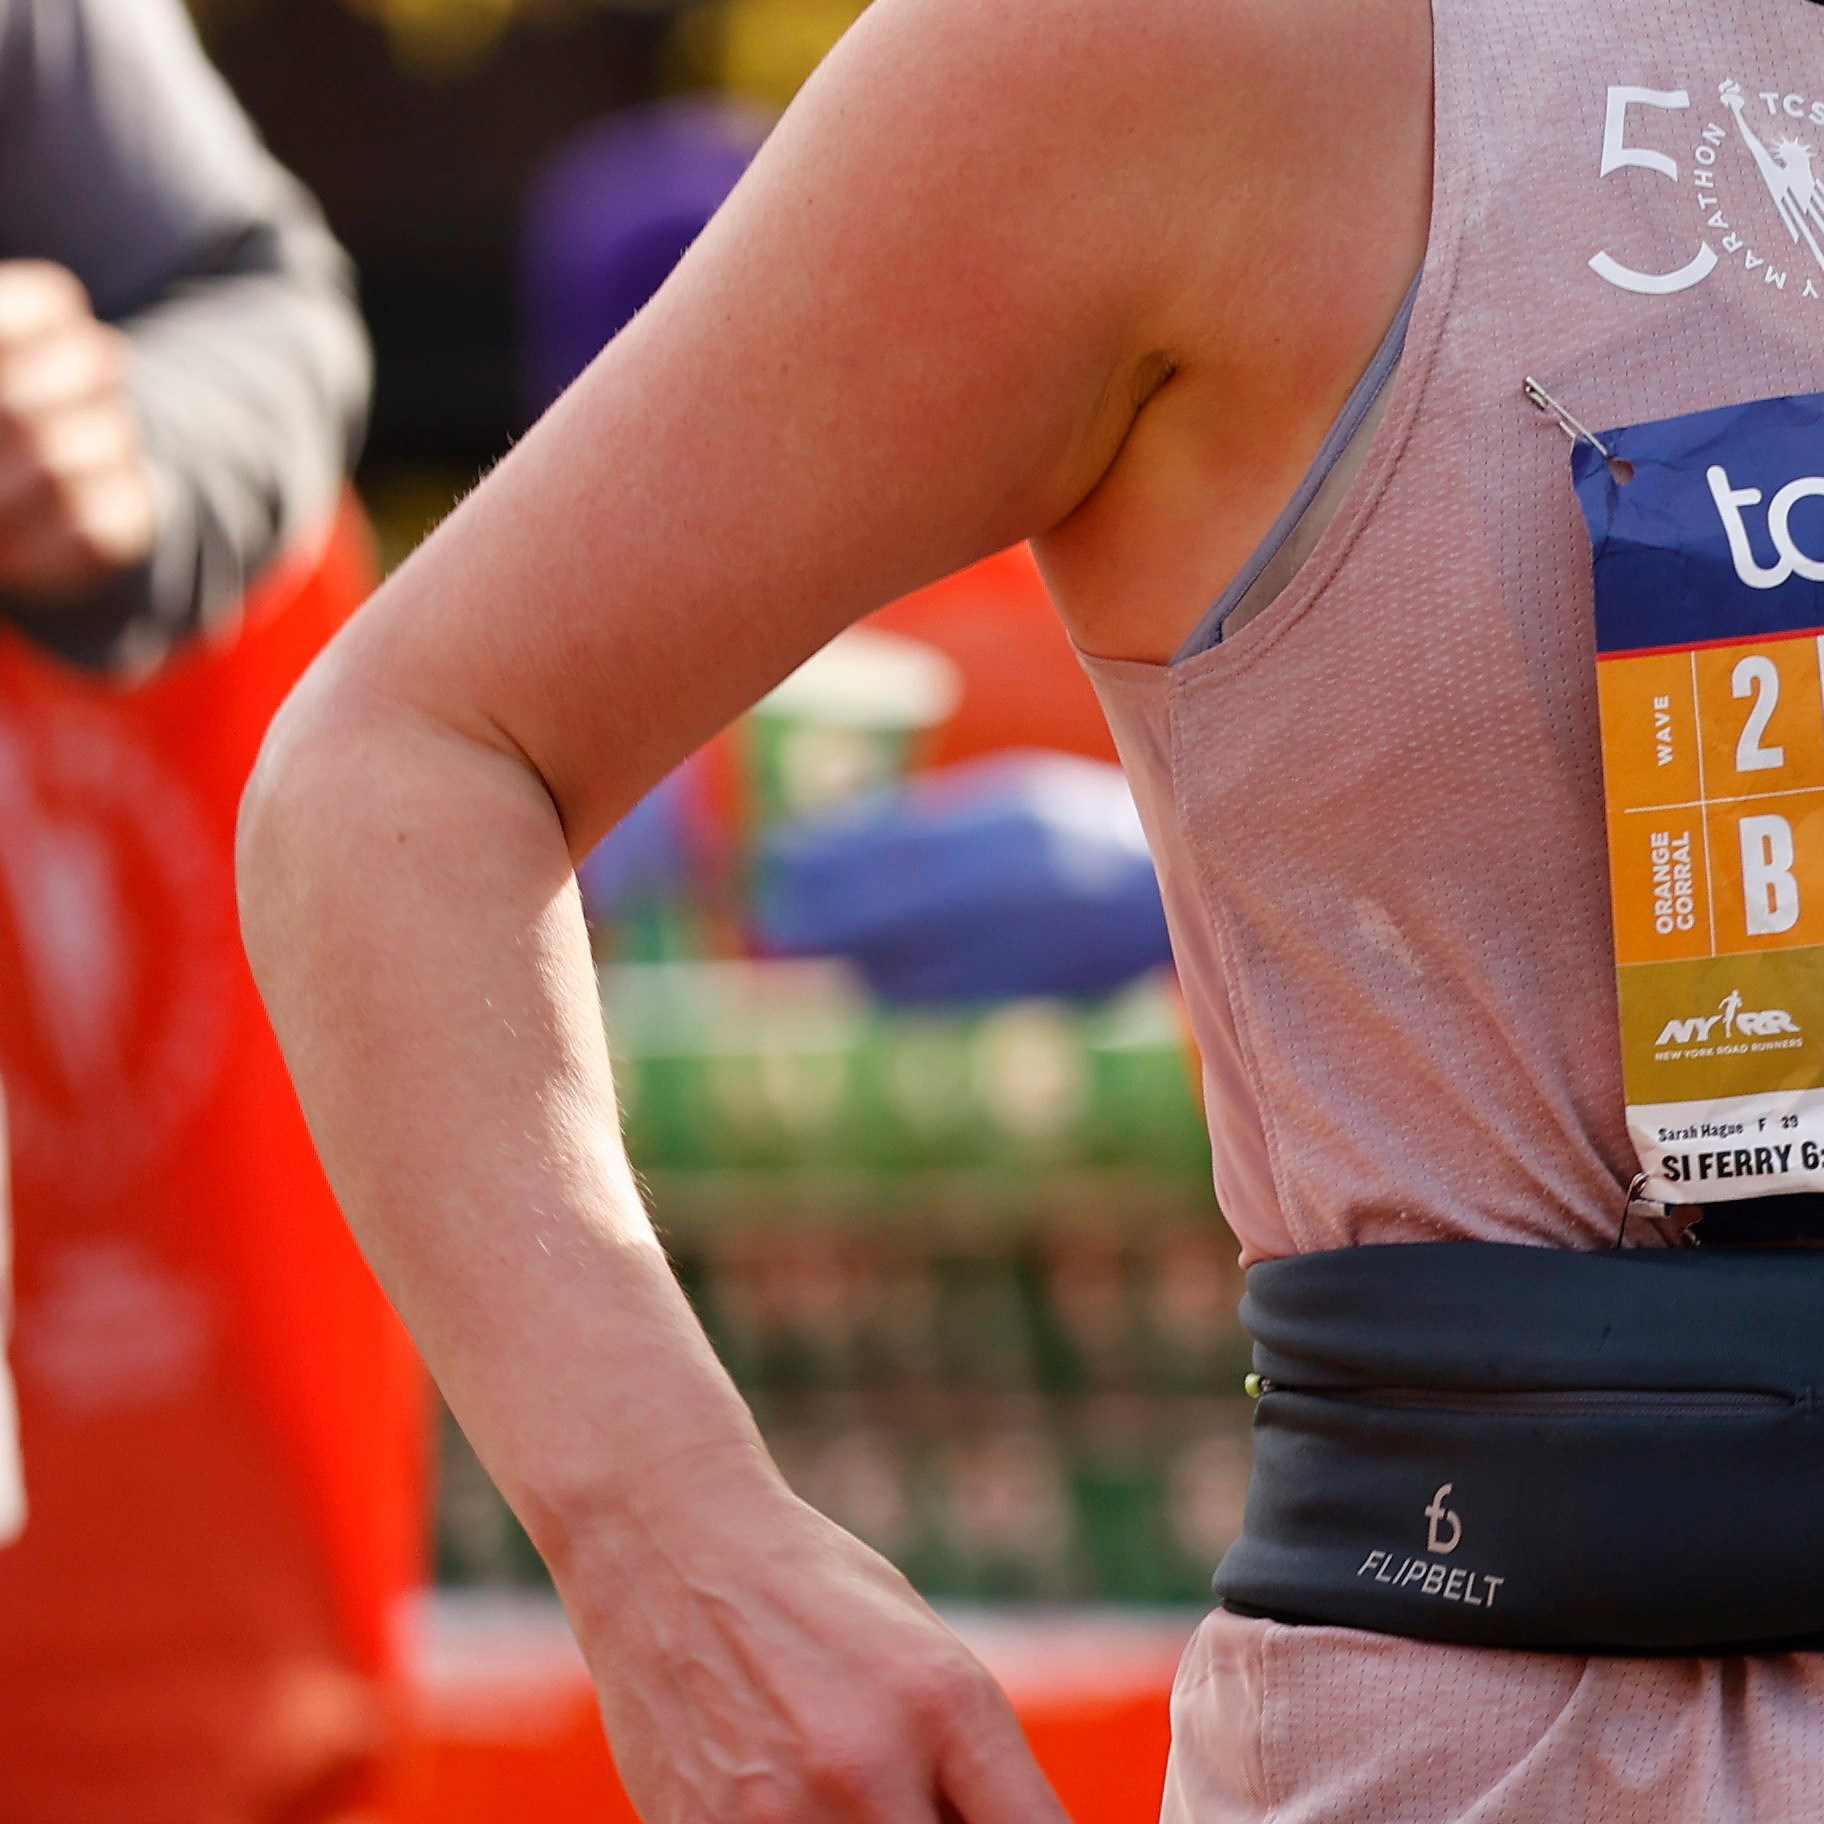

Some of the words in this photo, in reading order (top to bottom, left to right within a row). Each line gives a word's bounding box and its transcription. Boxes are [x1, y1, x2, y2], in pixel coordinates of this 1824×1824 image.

[1694, 122, 1787, 289] MARATHON
[1654, 695, 1674, 766] WAVE
[1731, 654, 1784, 773] 2
[1651, 831, 1673, 935] ORANGE
[1672, 830, 1695, 930] CORRAL
[1739, 814, 1800, 936] B
[1655, 1050, 1682, 1061] NEW
[1684, 1047, 1714, 1059] YORK
[1716, 1044, 1748, 1056] ROAD
[1751, 1037, 1803, 1052] RUNNERS
[1658, 1125, 1698, 1142] Sarah
[1758, 1118, 1767, 1132] F
[1662, 1155, 1691, 1182] SI
[1698, 1144, 1792, 1179] FERRY
[1357, 1549, 1504, 1608] FLIPBELT
